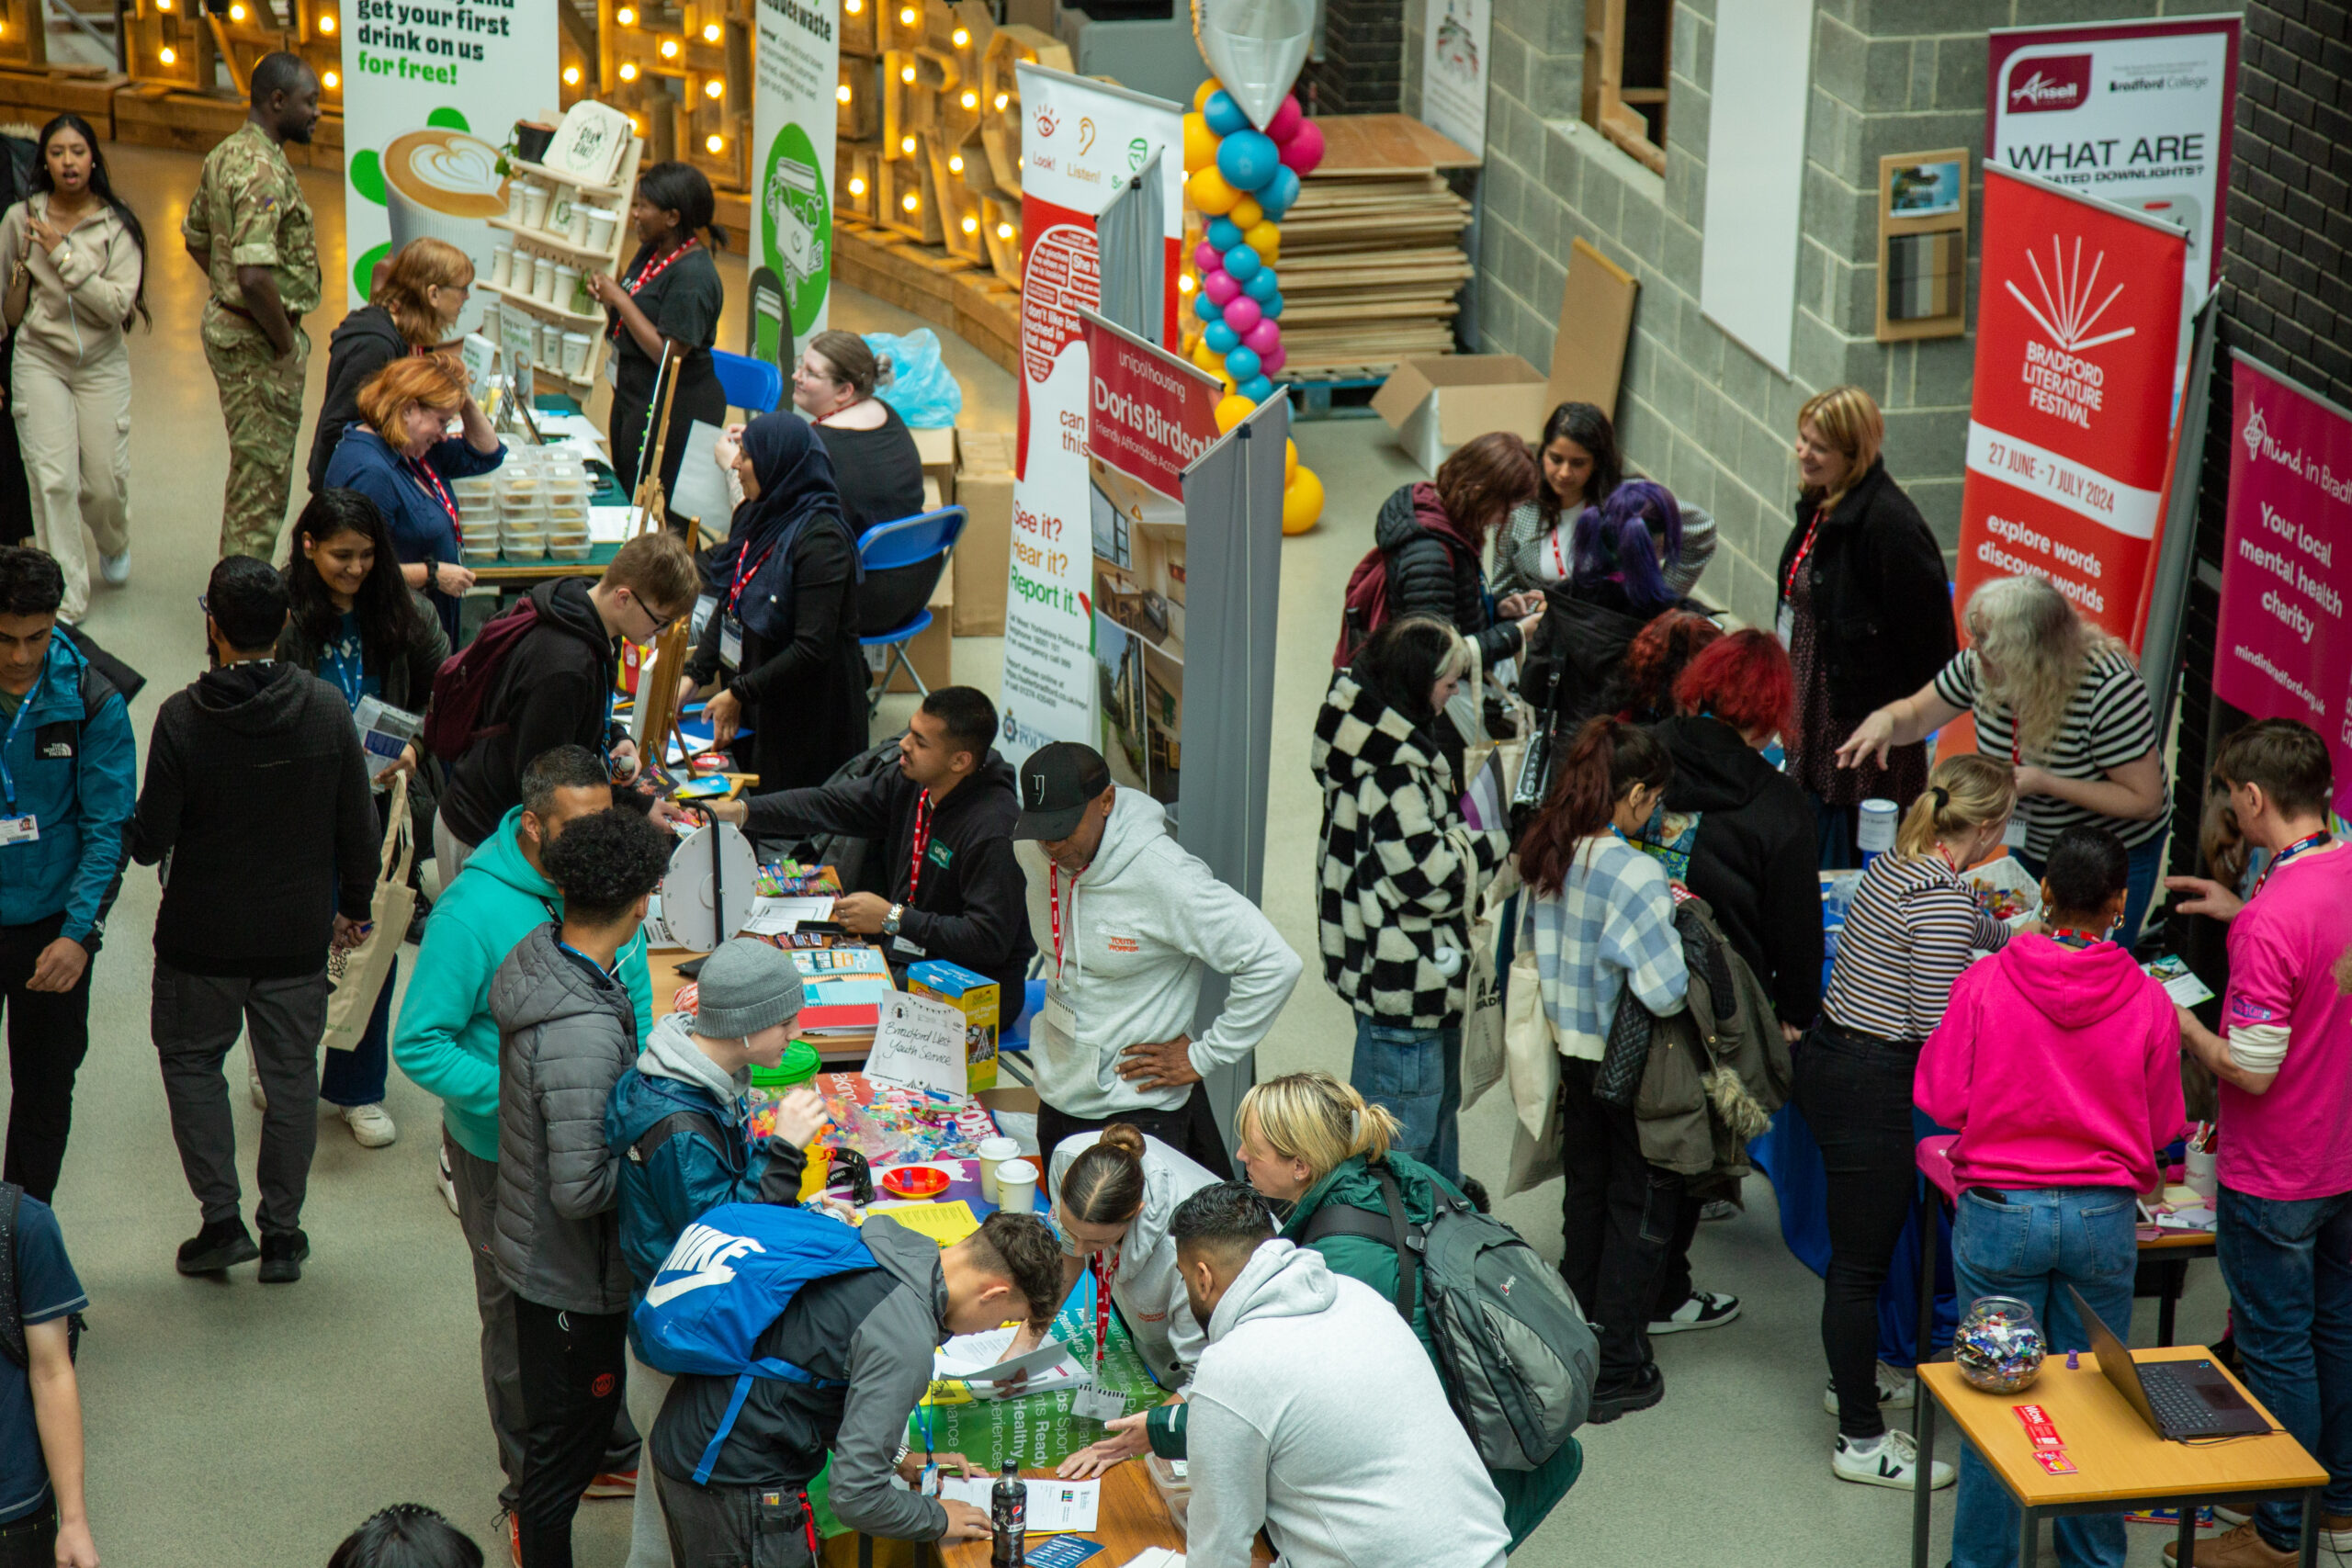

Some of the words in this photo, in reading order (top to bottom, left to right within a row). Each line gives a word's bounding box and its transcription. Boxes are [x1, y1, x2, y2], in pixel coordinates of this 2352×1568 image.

[357, 0, 394, 20] get
[398, 6, 453, 25] your
[457, 8, 510, 37] first
[358, 24, 421, 51] drink
[425, 37, 454, 56] on
[458, 41, 484, 61] us
[358, 51, 394, 75] for
[399, 57, 458, 85] free!
[2011, 71, 2077, 106] Ansell
[2109, 76, 2165, 93] Bradford
[2166, 74, 2209, 90] College
[1033, 152, 1056, 172] Look!
[2008, 138, 2120, 172] WHAT
[2129, 132, 2205, 164] ARE
[1067, 163, 1101, 185] Listen!
[2095, 164, 2205, 184] DOWNLIGHTS?
[1072, 254, 1091, 274] She
[2026, 340, 2105, 387] BRADFORD
[1094, 375, 1143, 432] Doris
[2022, 362, 2104, 412] LITERATURE
[2029, 387, 2091, 429] FESTIVAL
[1059, 410, 1086, 433] can
[1095, 418, 1120, 447] Friendly
[1145, 402, 1220, 460] Birdsa
[1062, 432, 1091, 457] this
[1988, 442, 2006, 466] 27
[2007, 448, 2038, 480] JUNE
[2048, 464, 2056, 487] 7
[2057, 469, 2086, 500] JULY
[2086, 480, 2116, 514] 2024
[2306, 456, 2320, 485] in
[1013, 499, 1037, 535] See
[1042, 513, 1062, 542] it?
[2260, 501, 2296, 542] Your
[2298, 524, 2332, 569] local
[1012, 532, 1043, 569] Hear
[1047, 548, 1069, 578] it?
[1986, 514, 2051, 554] explore
[2053, 540, 2102, 579] words
[1011, 563, 1059, 609] Report
[1064, 588, 1079, 617] it.
[1977, 540, 2050, 580] discover
[2052, 572, 2106, 614] worlds
[2239, 537, 2295, 586] mental
[2297, 566, 2344, 618] health
[2261, 589, 2314, 644] charity
[1110, 936, 1136, 945] YOUTH
[882, 1039, 918, 1059] Youth
[919, 1045, 953, 1066] Service
[885, 1021, 933, 1043] Bradford
[660, 1223, 766, 1274] NIKE
[1057, 1310, 1077, 1338] Creative
[1072, 1335, 1087, 1353] Arts
[1117, 1337, 1132, 1356] Fun
[1140, 1382, 1158, 1395] DJ
[1010, 1399, 1028, 1459] Healthy
[1030, 1421, 1050, 1469] Ready
[1057, 1416, 1072, 1457] Sport
